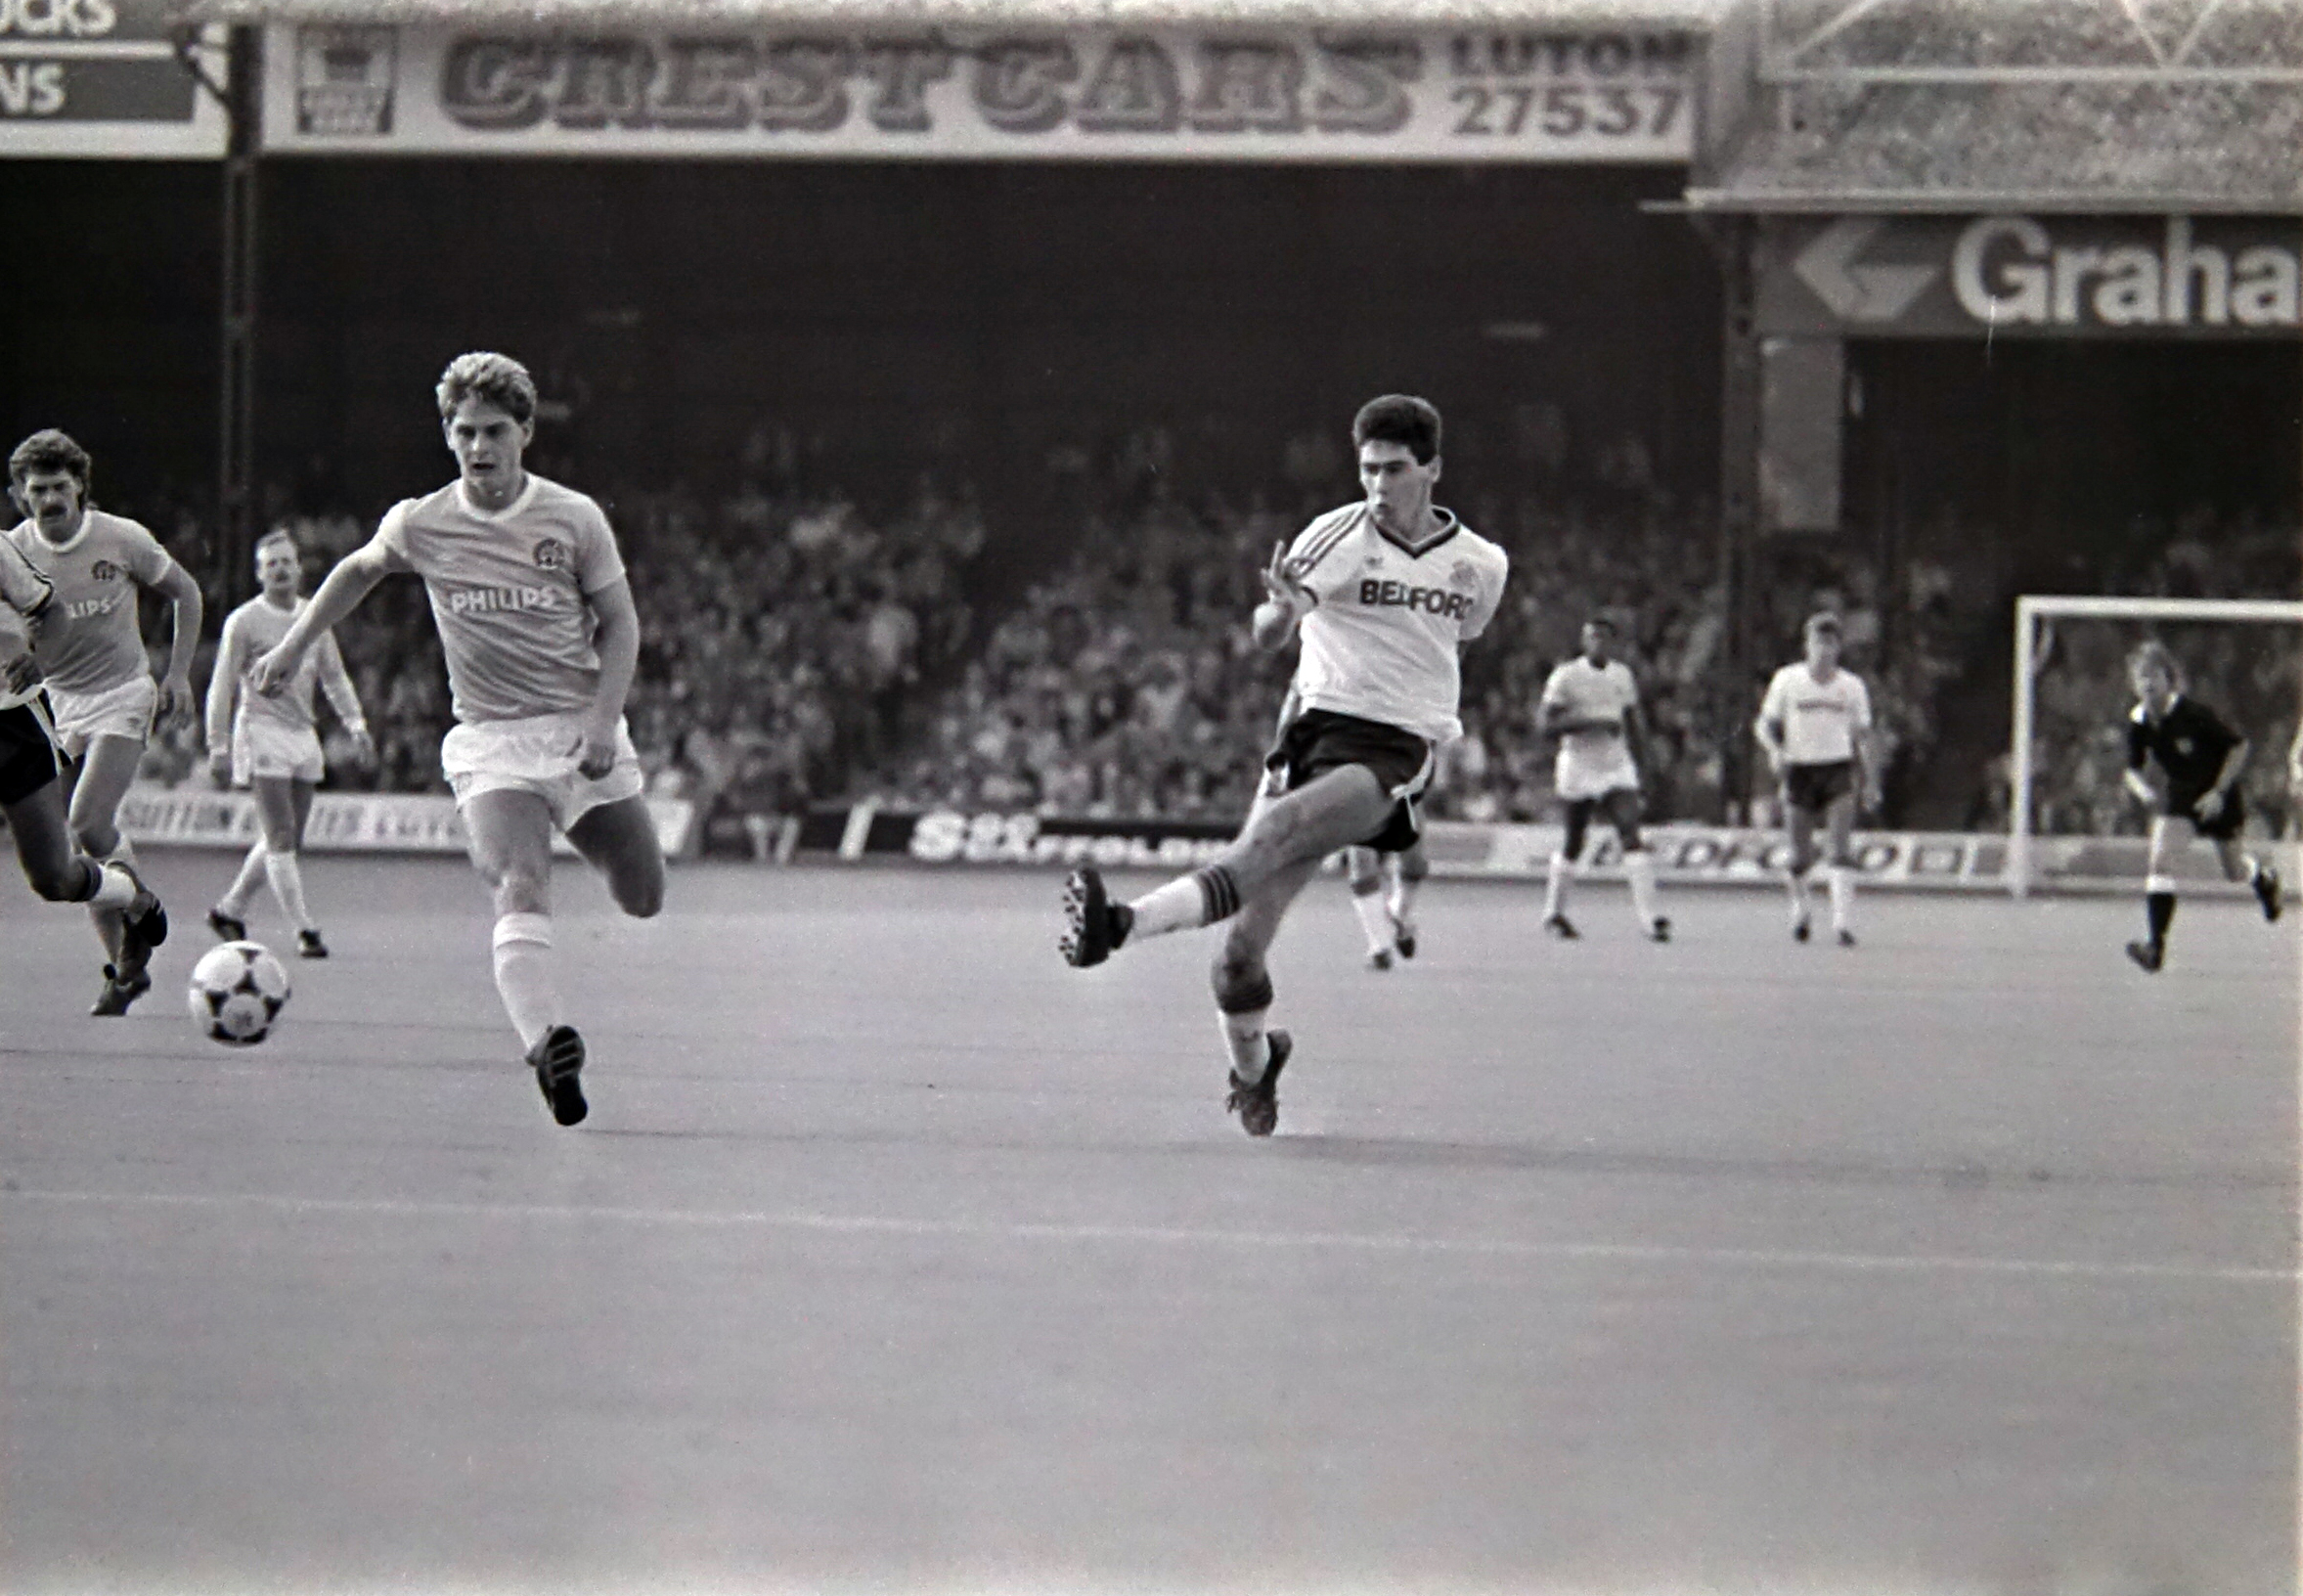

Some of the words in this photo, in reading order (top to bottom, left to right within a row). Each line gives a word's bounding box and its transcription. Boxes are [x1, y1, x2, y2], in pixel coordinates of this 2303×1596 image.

[439, 35, 951, 132] CREST
[970, 36, 1425, 132] CARS
[1451, 84, 1684, 136] 27537
[1954, 214, 2303, 327] Graha
[451, 587, 555, 613] PHILIPS
